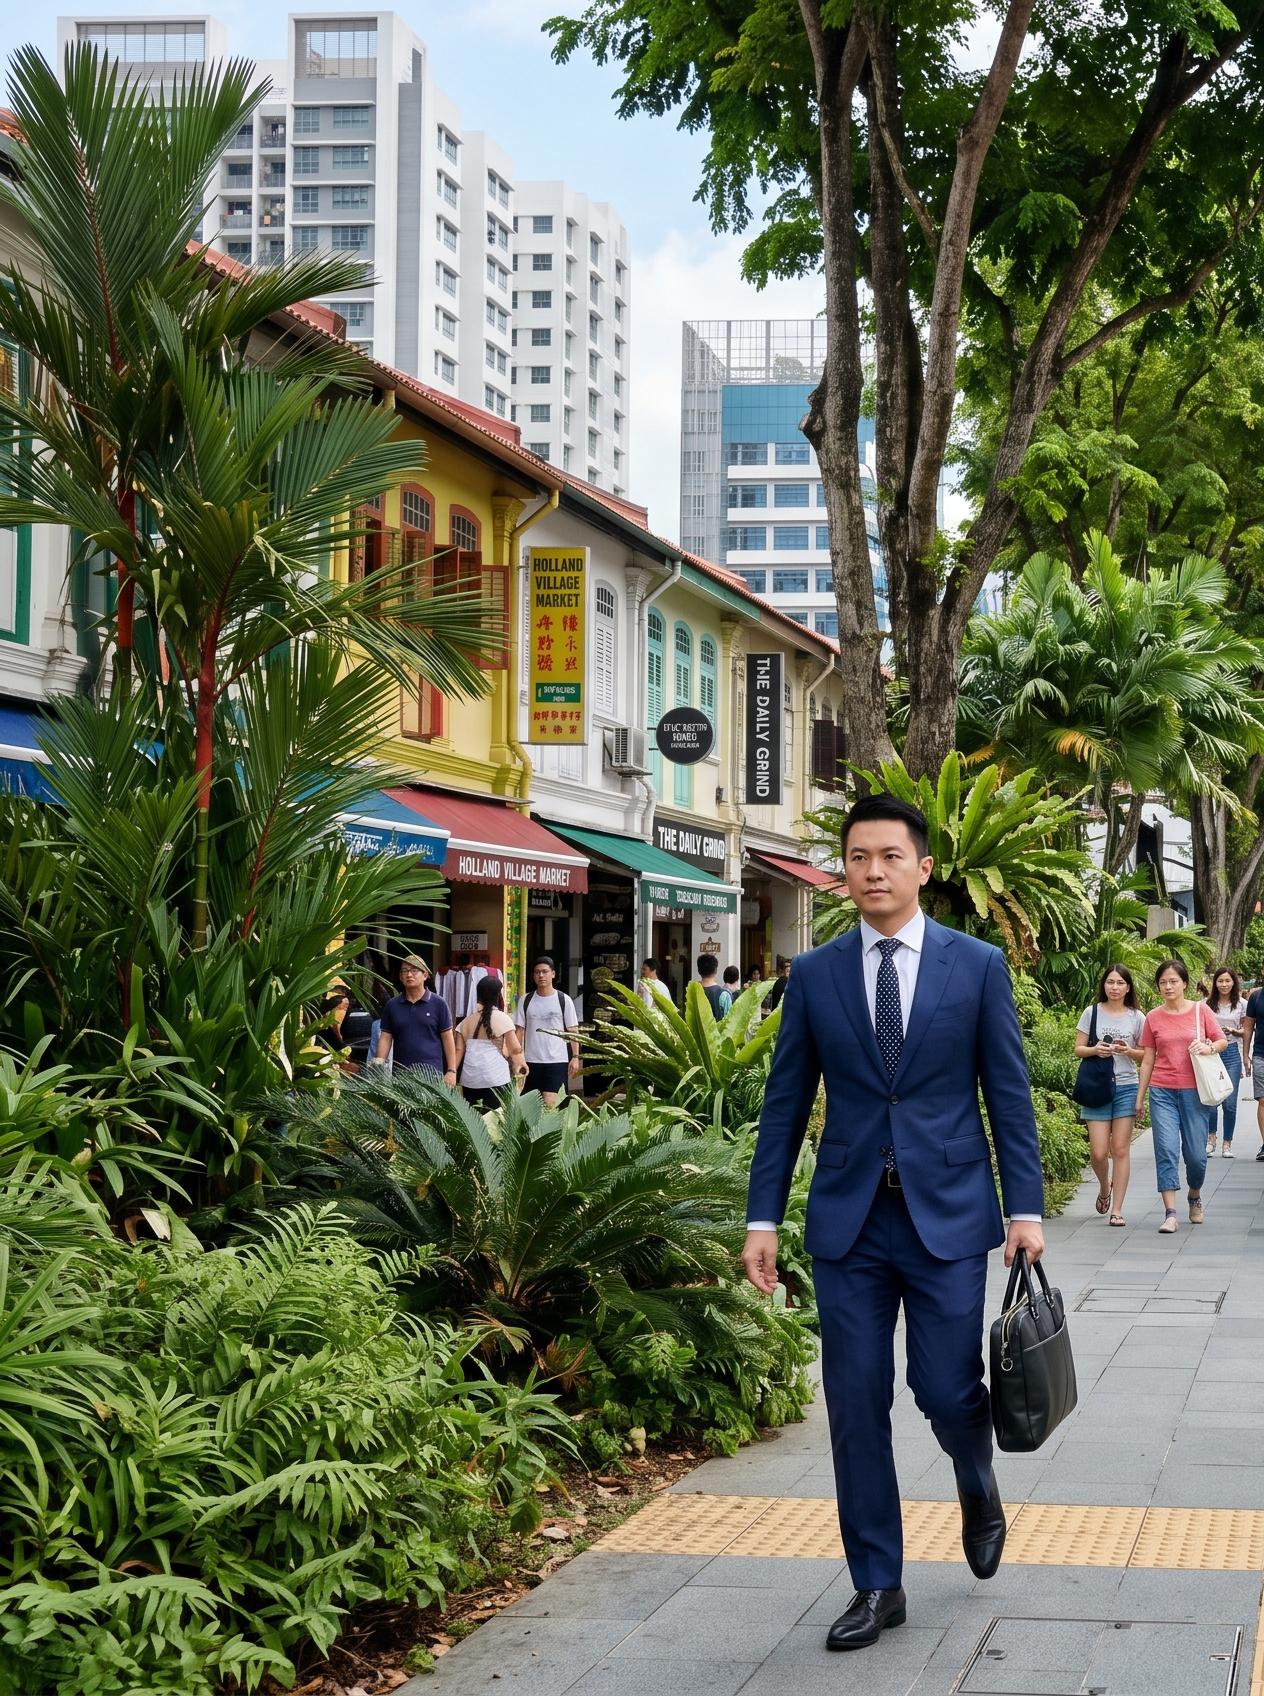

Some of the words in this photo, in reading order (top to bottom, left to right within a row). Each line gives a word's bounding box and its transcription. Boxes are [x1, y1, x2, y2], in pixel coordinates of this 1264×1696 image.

[533, 558, 583, 572] HOLLAND
[535, 576, 580, 590] VILLAGE
[536, 594, 580, 608] MARKET
[756, 657, 770, 690] THE
[756, 695, 770, 741] DAILY
[756, 747, 770, 797] GRIND
[657, 826, 677, 851] THE
[679, 830, 702, 856] DAILY
[459, 856, 500, 879] HOLLAND
[503, 861, 537, 883] VILLAGE
[539, 866, 571, 887] MARKET
